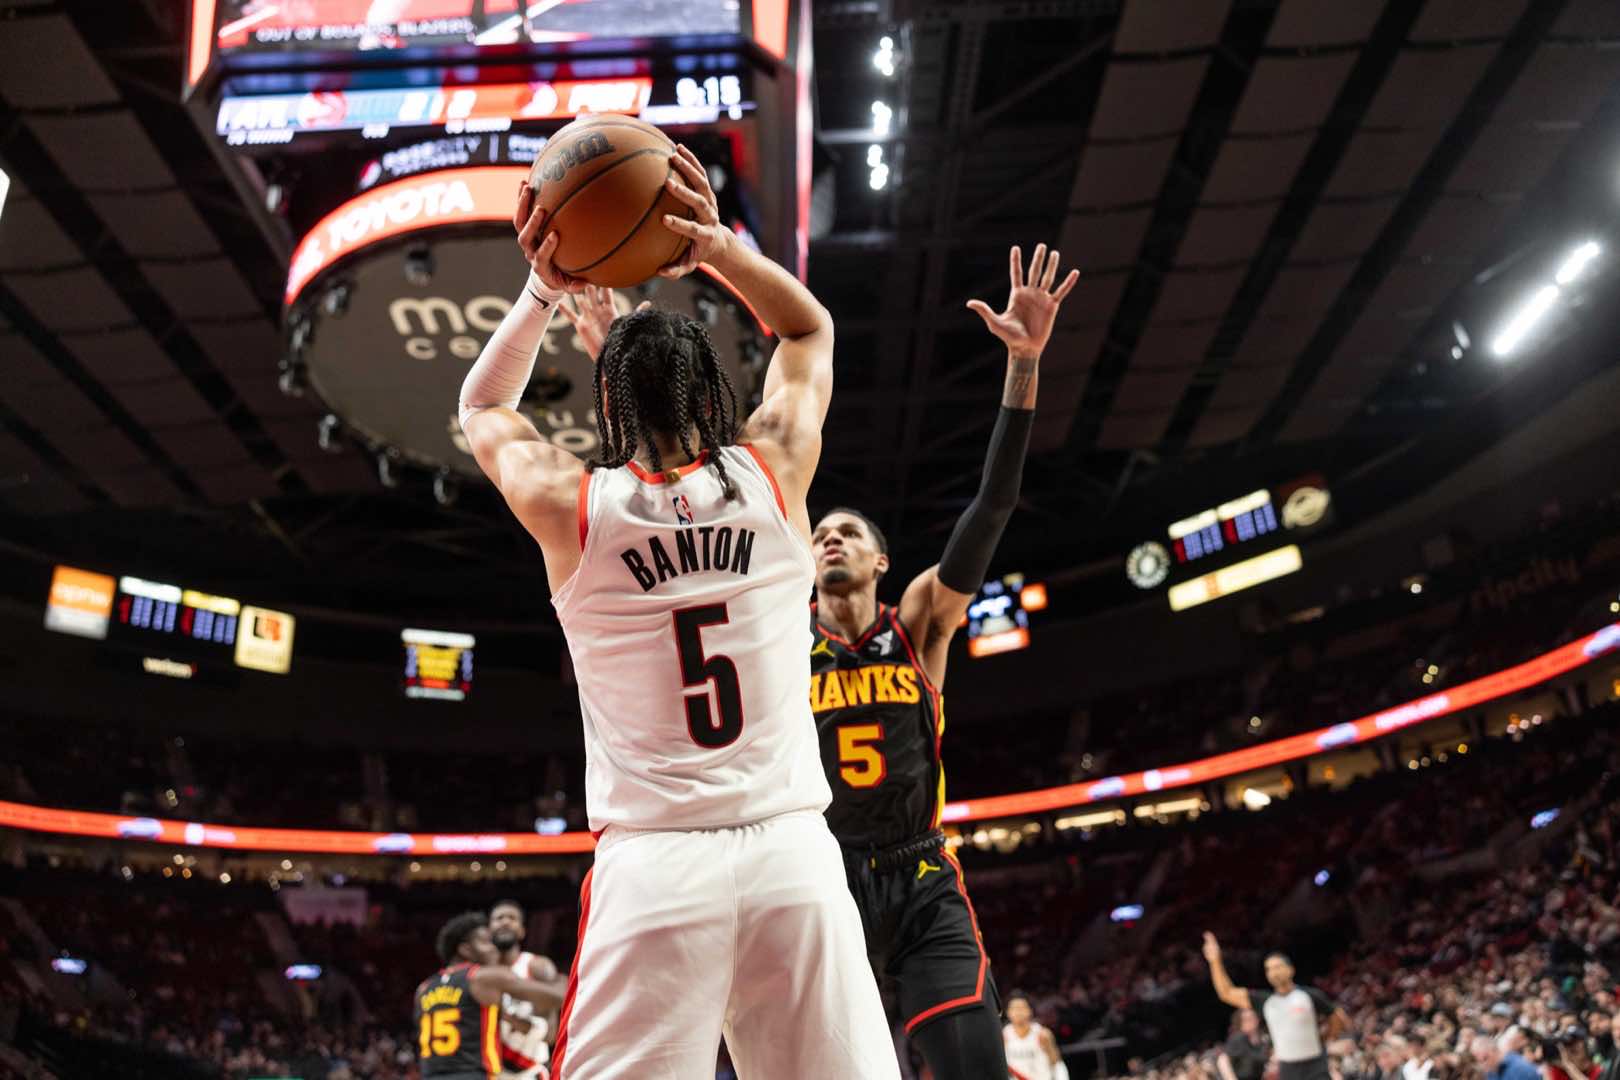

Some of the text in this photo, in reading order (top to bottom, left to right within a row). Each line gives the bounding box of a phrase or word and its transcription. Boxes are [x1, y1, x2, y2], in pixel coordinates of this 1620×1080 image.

[328, 180, 475, 251] TOYOTA
[620, 526, 756, 593] BANTON
[672, 602, 744, 749] 5
[837, 723, 887, 788] 5
[419, 1007, 462, 1059] 15
